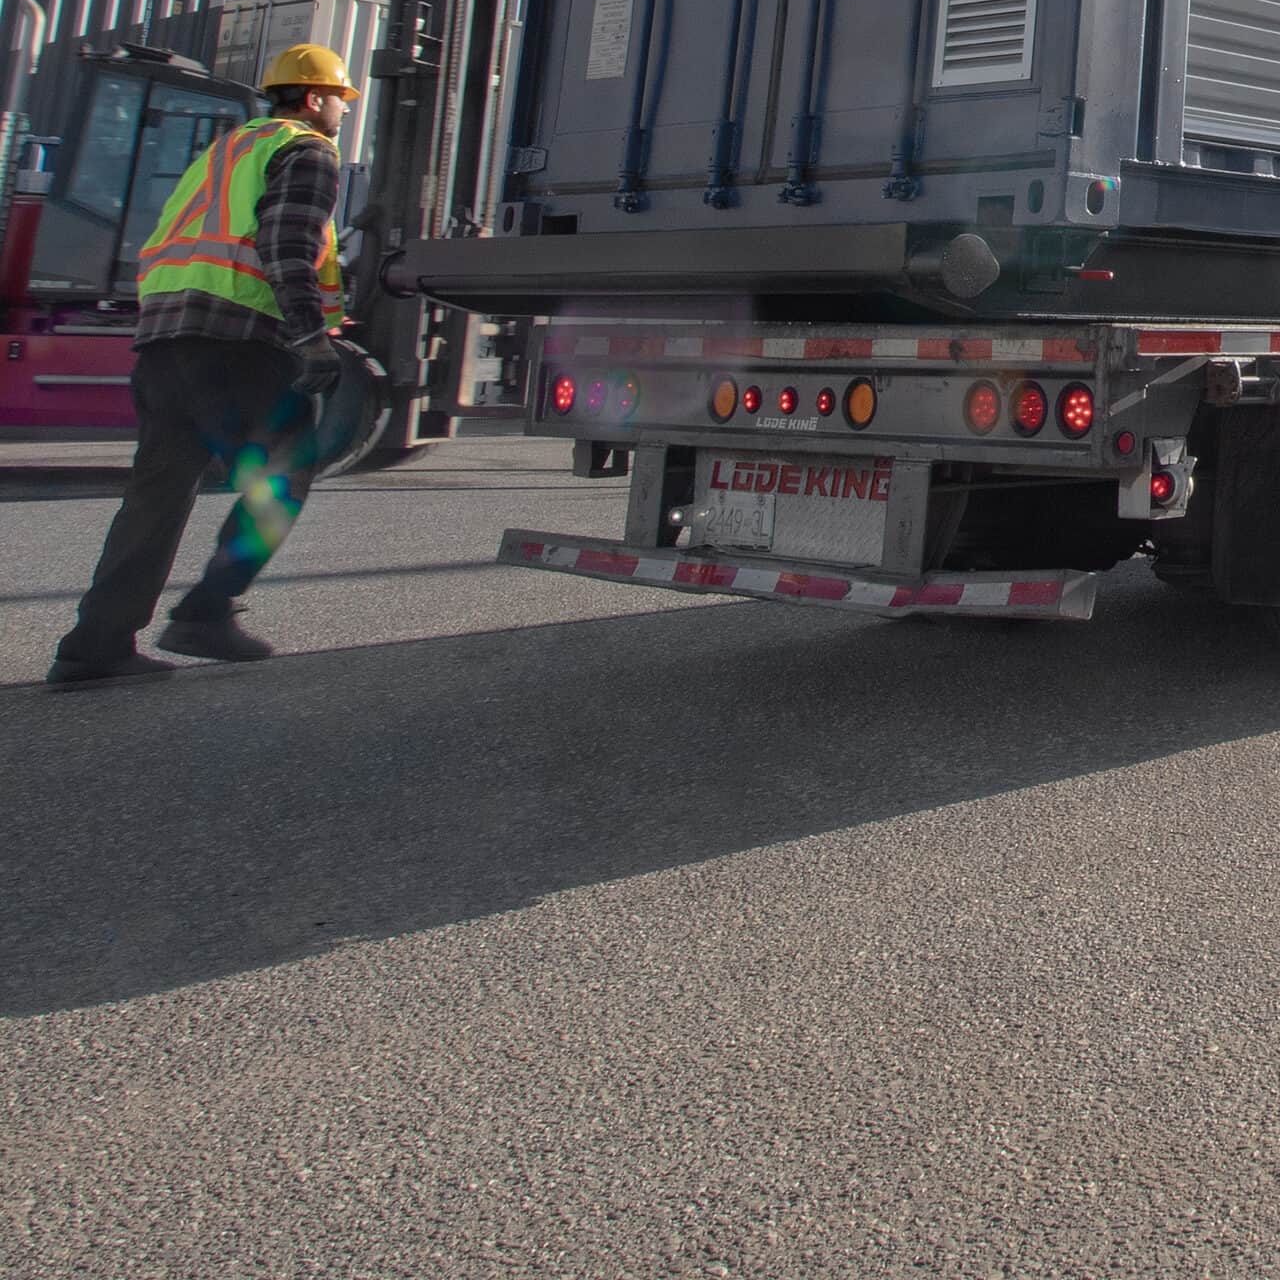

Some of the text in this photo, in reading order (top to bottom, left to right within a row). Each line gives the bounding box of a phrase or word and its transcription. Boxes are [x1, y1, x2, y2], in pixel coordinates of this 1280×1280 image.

[756, 417, 818, 431] LODE KING
[710, 460, 892, 501] LODE KING
